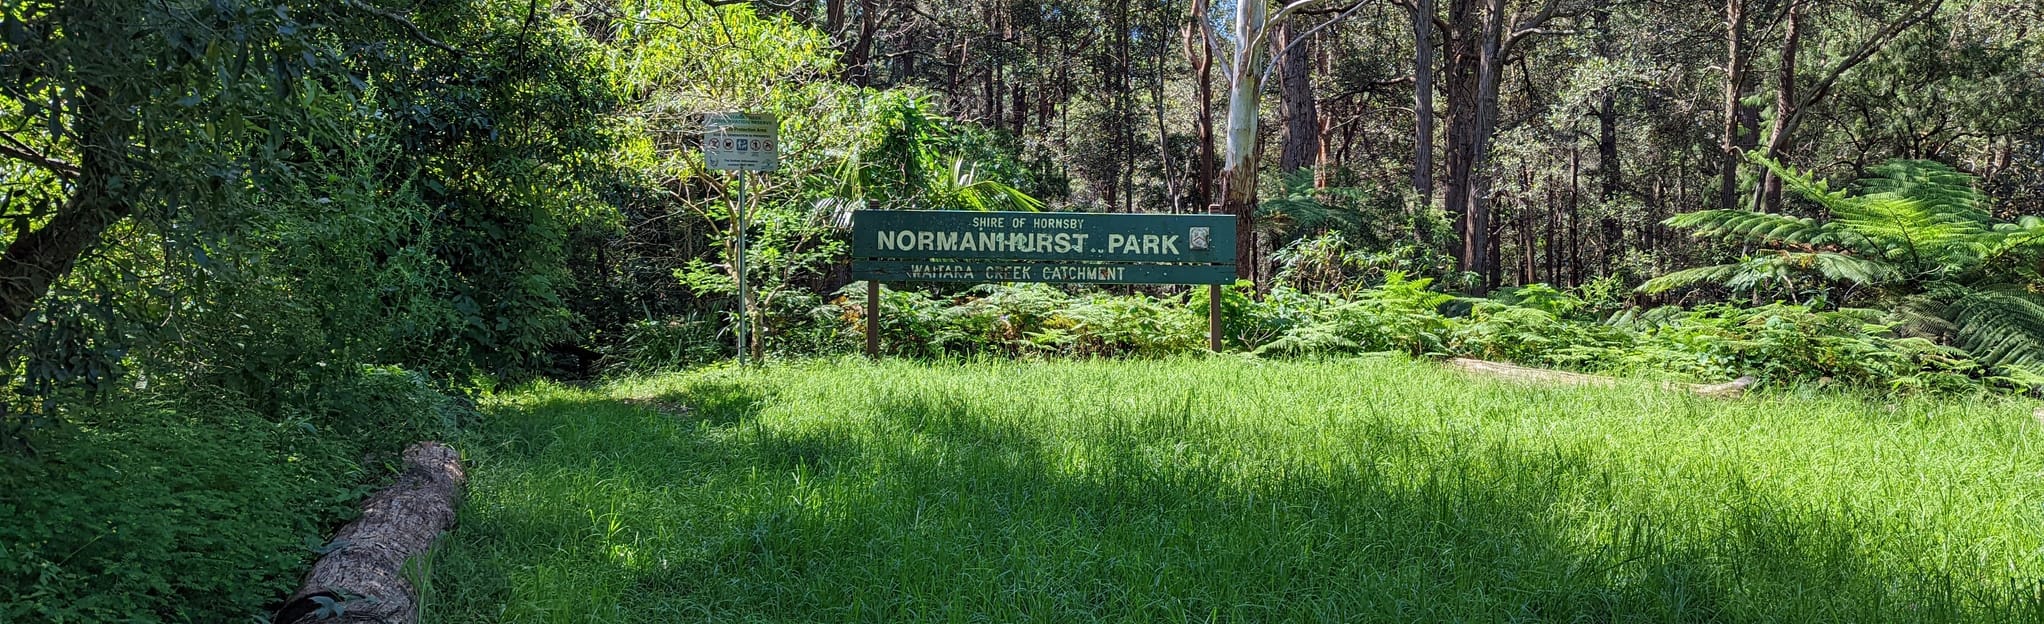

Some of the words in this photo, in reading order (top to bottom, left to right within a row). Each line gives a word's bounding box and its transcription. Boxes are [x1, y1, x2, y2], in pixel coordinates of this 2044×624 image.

[972, 217, 1005, 228] SHIRE
[1012, 217, 1026, 228] OF
[1033, 218, 1084, 229] HORNSBY
[877, 230, 1089, 253] NORMANHURST
[1108, 233, 1180, 255] PARK
[911, 264, 974, 279] WAITARA
[985, 265, 1031, 280] CREEK
[1042, 266, 1126, 281] CATCHMENT
